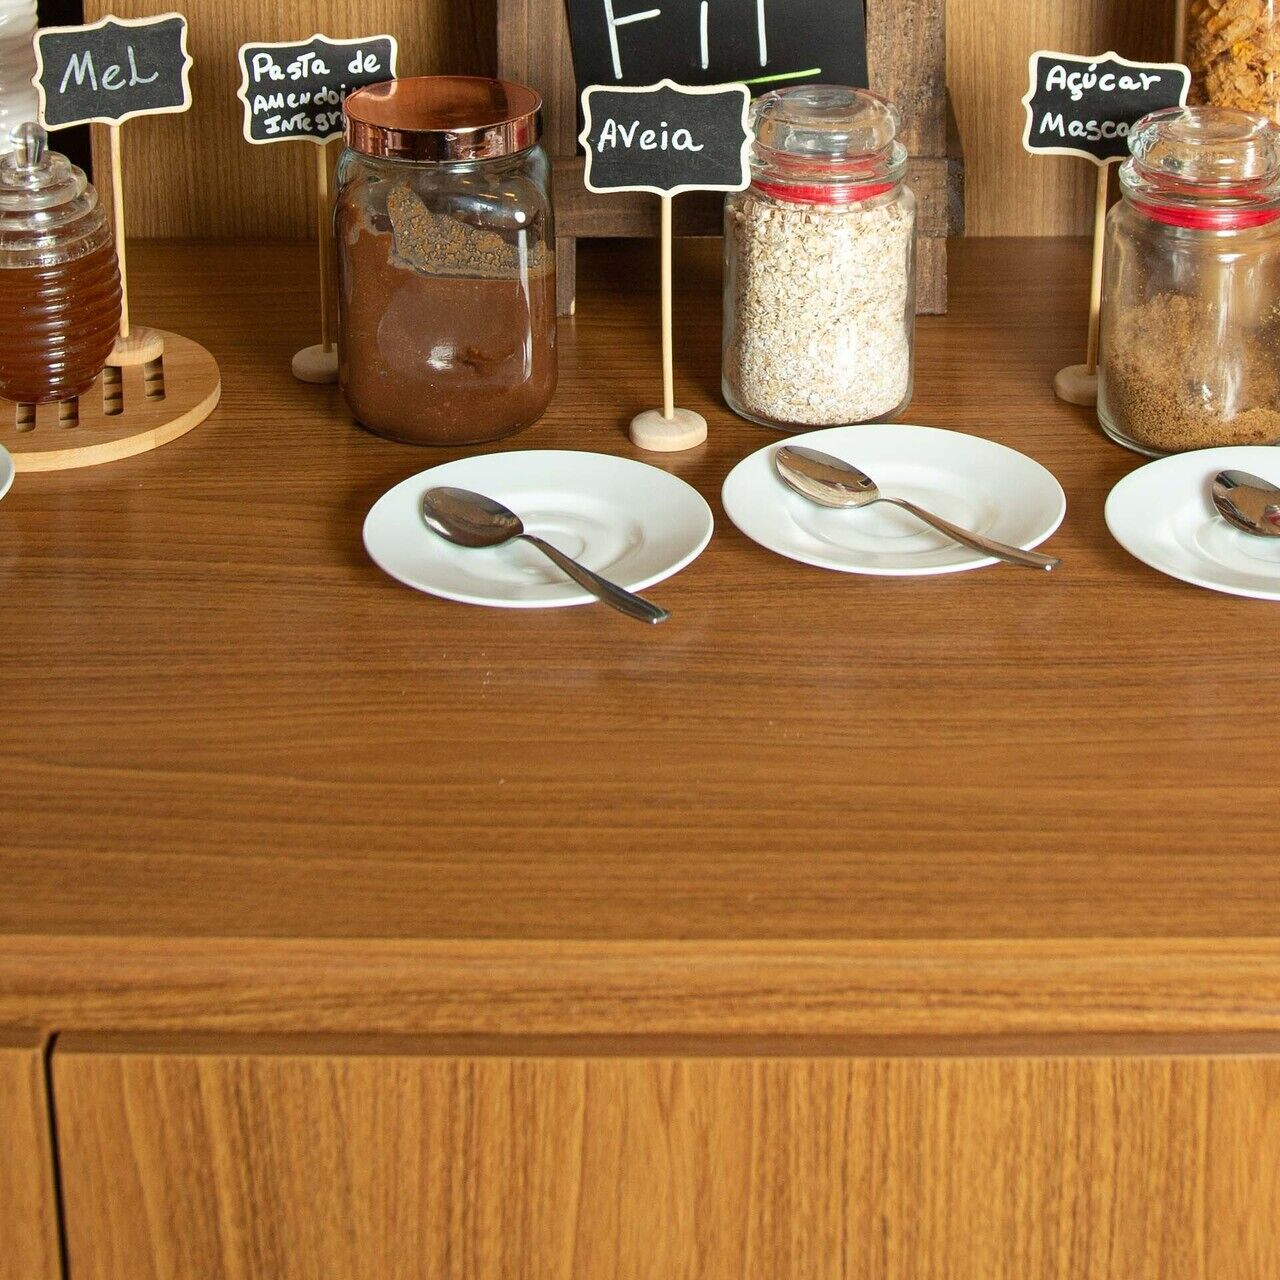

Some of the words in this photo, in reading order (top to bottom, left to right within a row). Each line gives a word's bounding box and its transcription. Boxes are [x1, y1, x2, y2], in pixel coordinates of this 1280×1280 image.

[348, 50, 381, 74] de
[1046, 63, 1161, 101] Açúcar
[1039, 111, 1131, 141] Masca
